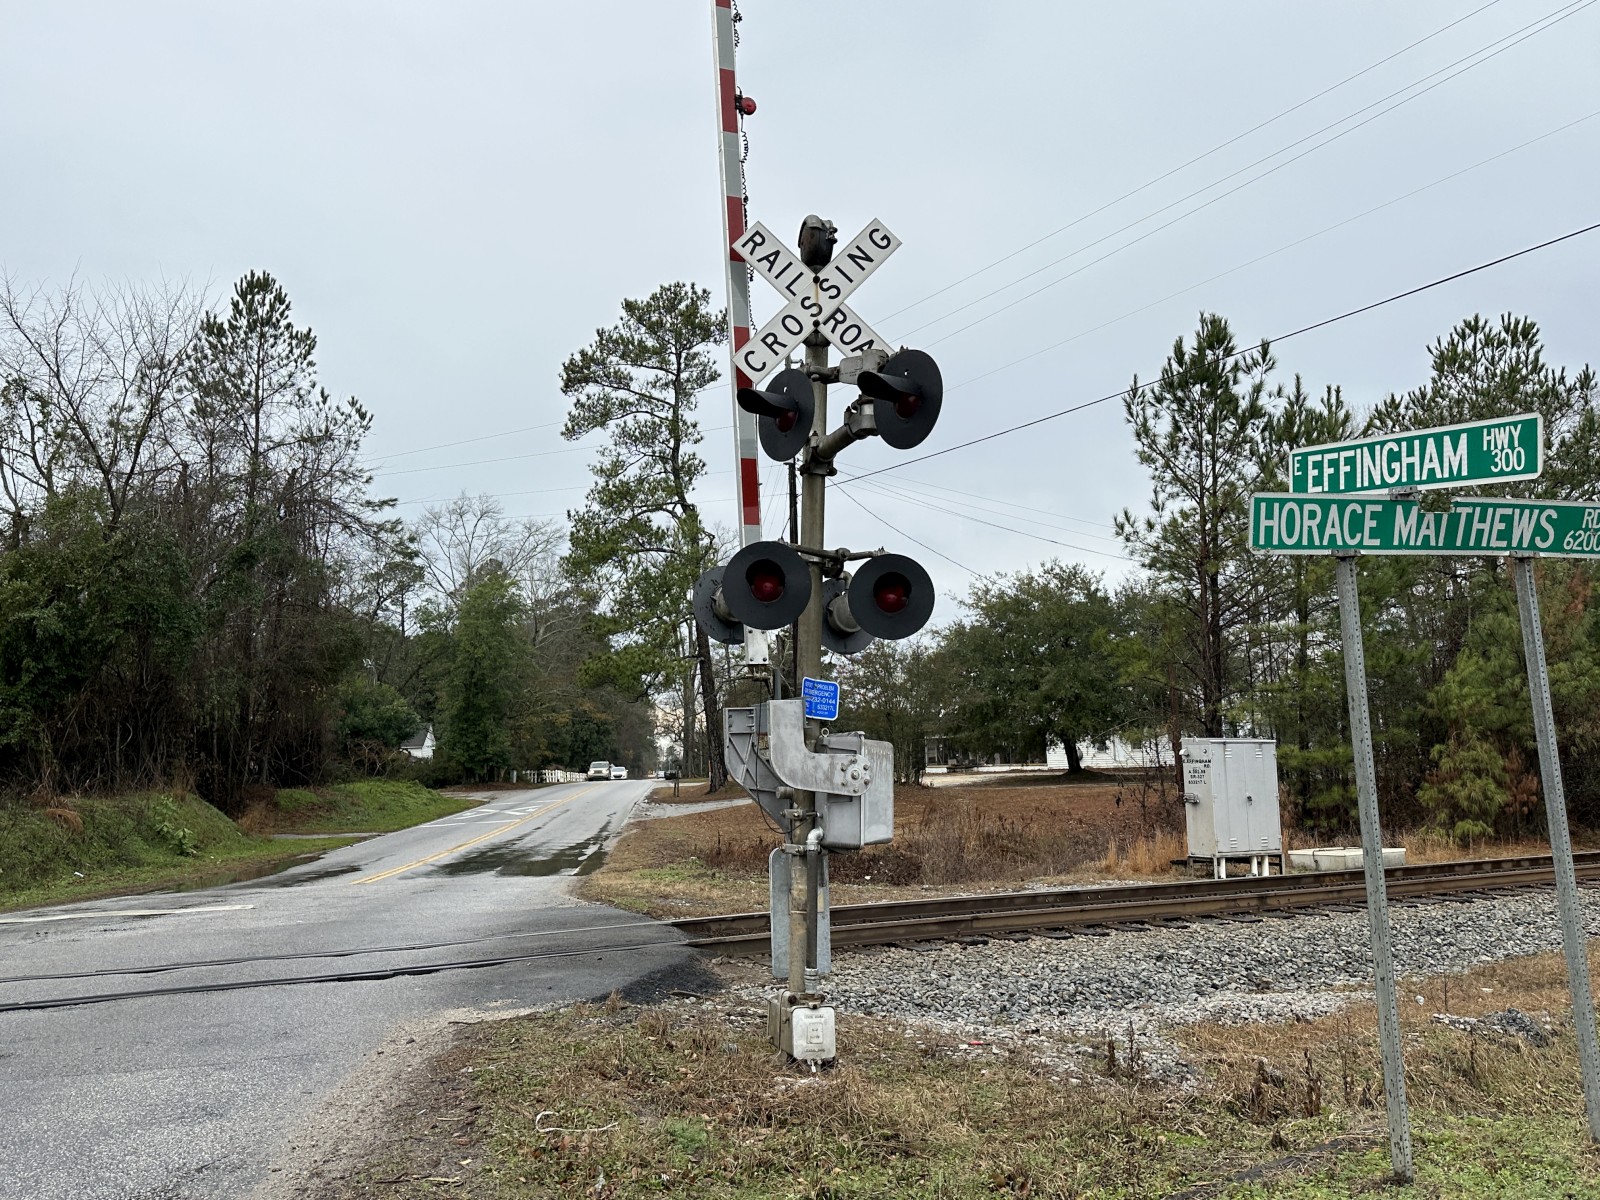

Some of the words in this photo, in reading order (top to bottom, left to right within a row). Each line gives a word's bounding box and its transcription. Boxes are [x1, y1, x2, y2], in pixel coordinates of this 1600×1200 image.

[741, 230, 804, 297] RAIL
[822, 307, 876, 356] ROA
[744, 228, 891, 373] CROSSING
[1293, 455, 1302, 476] E
[1307, 432, 1468, 493] EFFINGHAM
[1483, 424, 1522, 451] HWY
[1490, 446, 1526, 473] 300
[1259, 501, 1383, 546] HORACE
[1393, 504, 1558, 549] MATTHEWS
